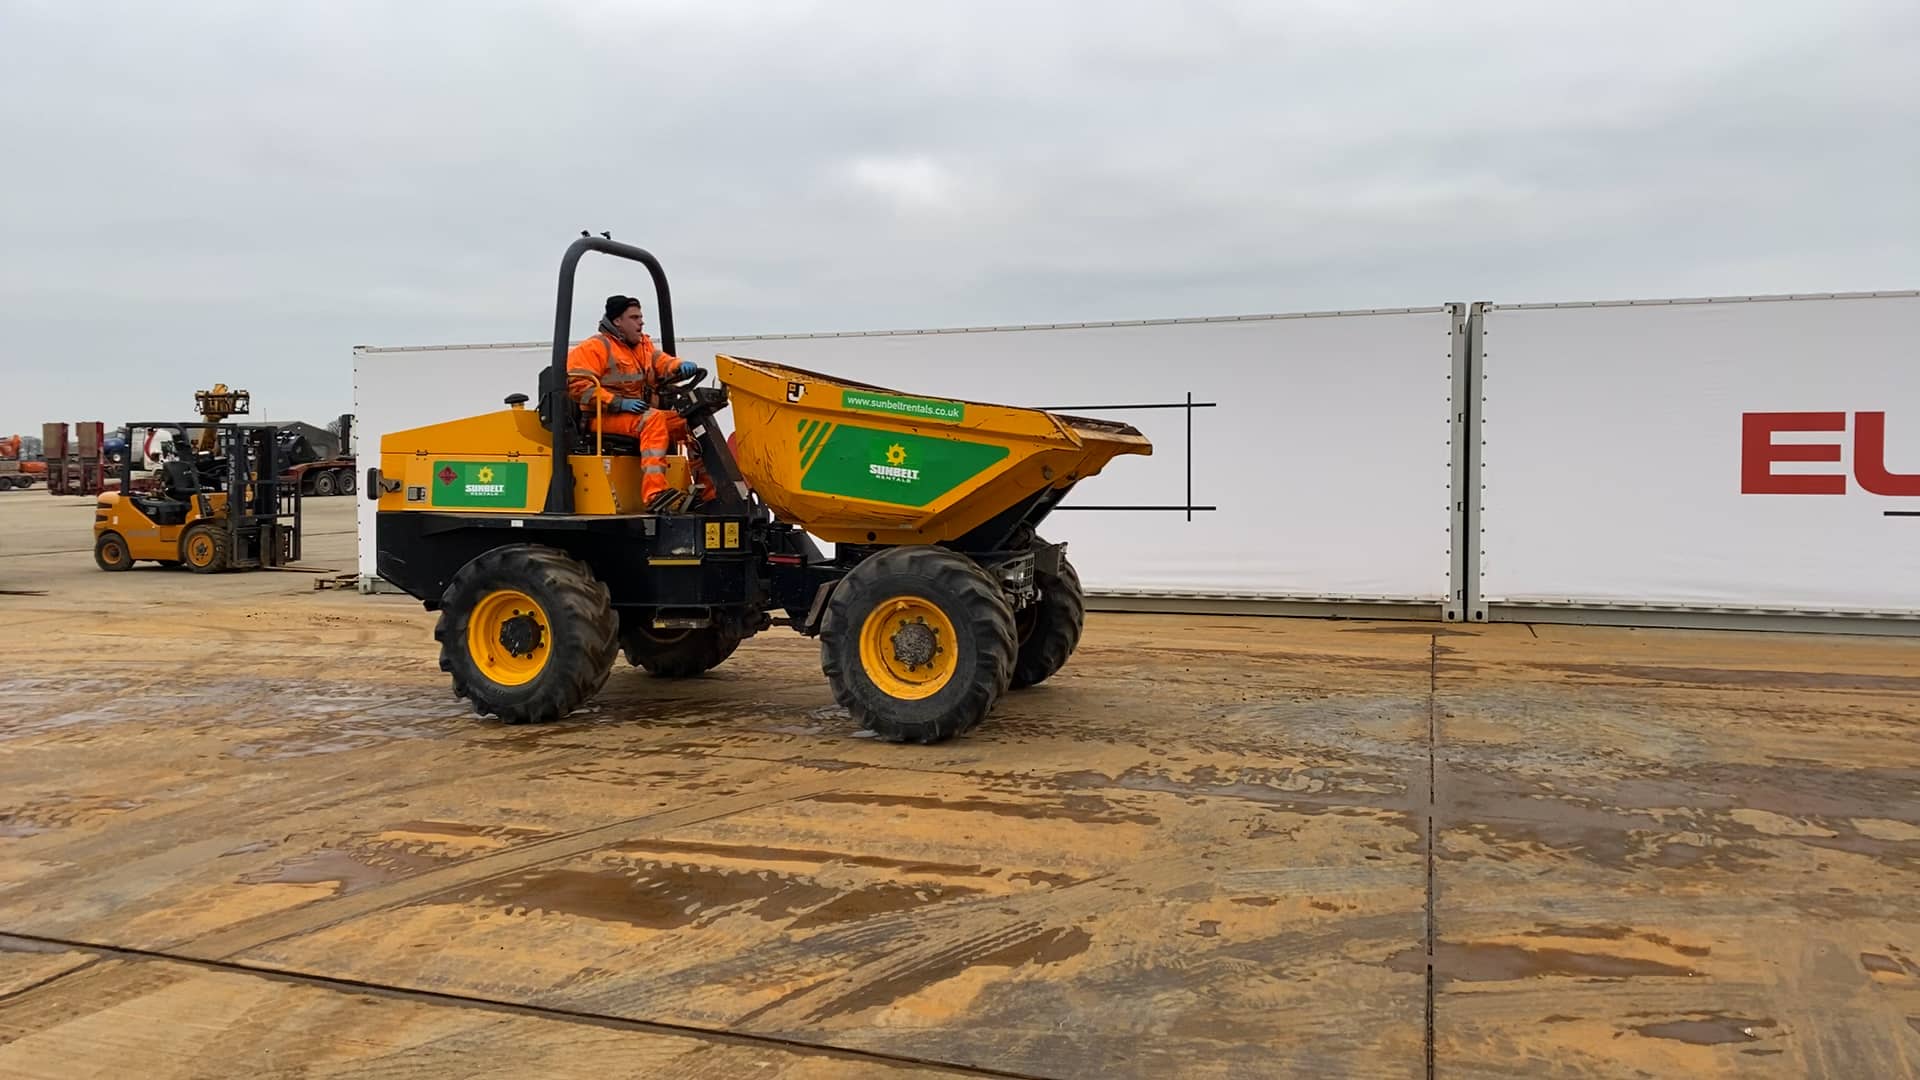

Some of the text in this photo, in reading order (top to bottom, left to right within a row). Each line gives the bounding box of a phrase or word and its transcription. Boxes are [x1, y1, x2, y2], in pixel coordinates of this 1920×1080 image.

[847, 396, 959, 418] www.sunbeltrentals.co.uk
[1741, 411, 1920, 496] EU
[869, 464, 920, 480] SUNBELT
[465, 484, 505, 493] SUNBELT
